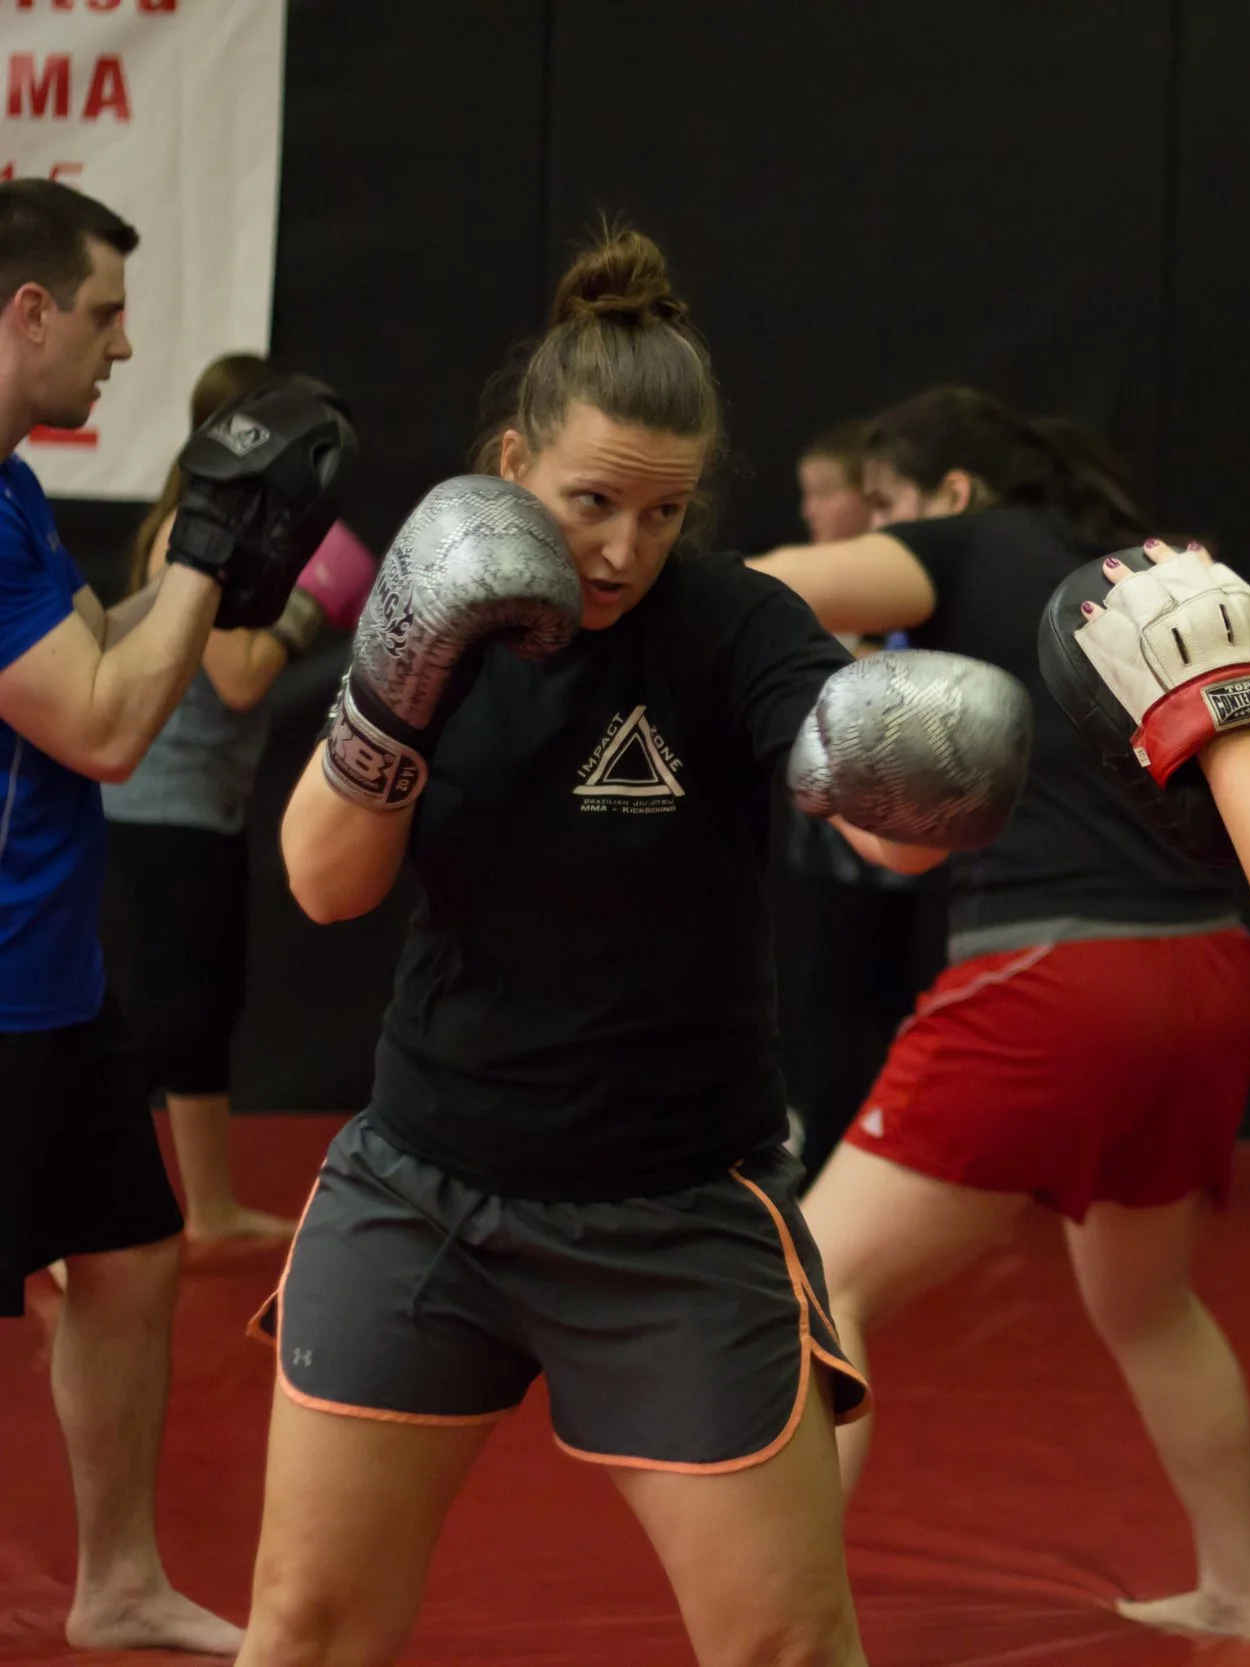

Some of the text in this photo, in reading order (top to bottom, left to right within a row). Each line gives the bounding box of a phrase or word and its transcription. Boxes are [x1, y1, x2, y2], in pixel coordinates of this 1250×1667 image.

[1225, 682, 1250, 693] TOP
[577, 712, 625, 778] IMPACT
[580, 804, 607, 812] MMA
